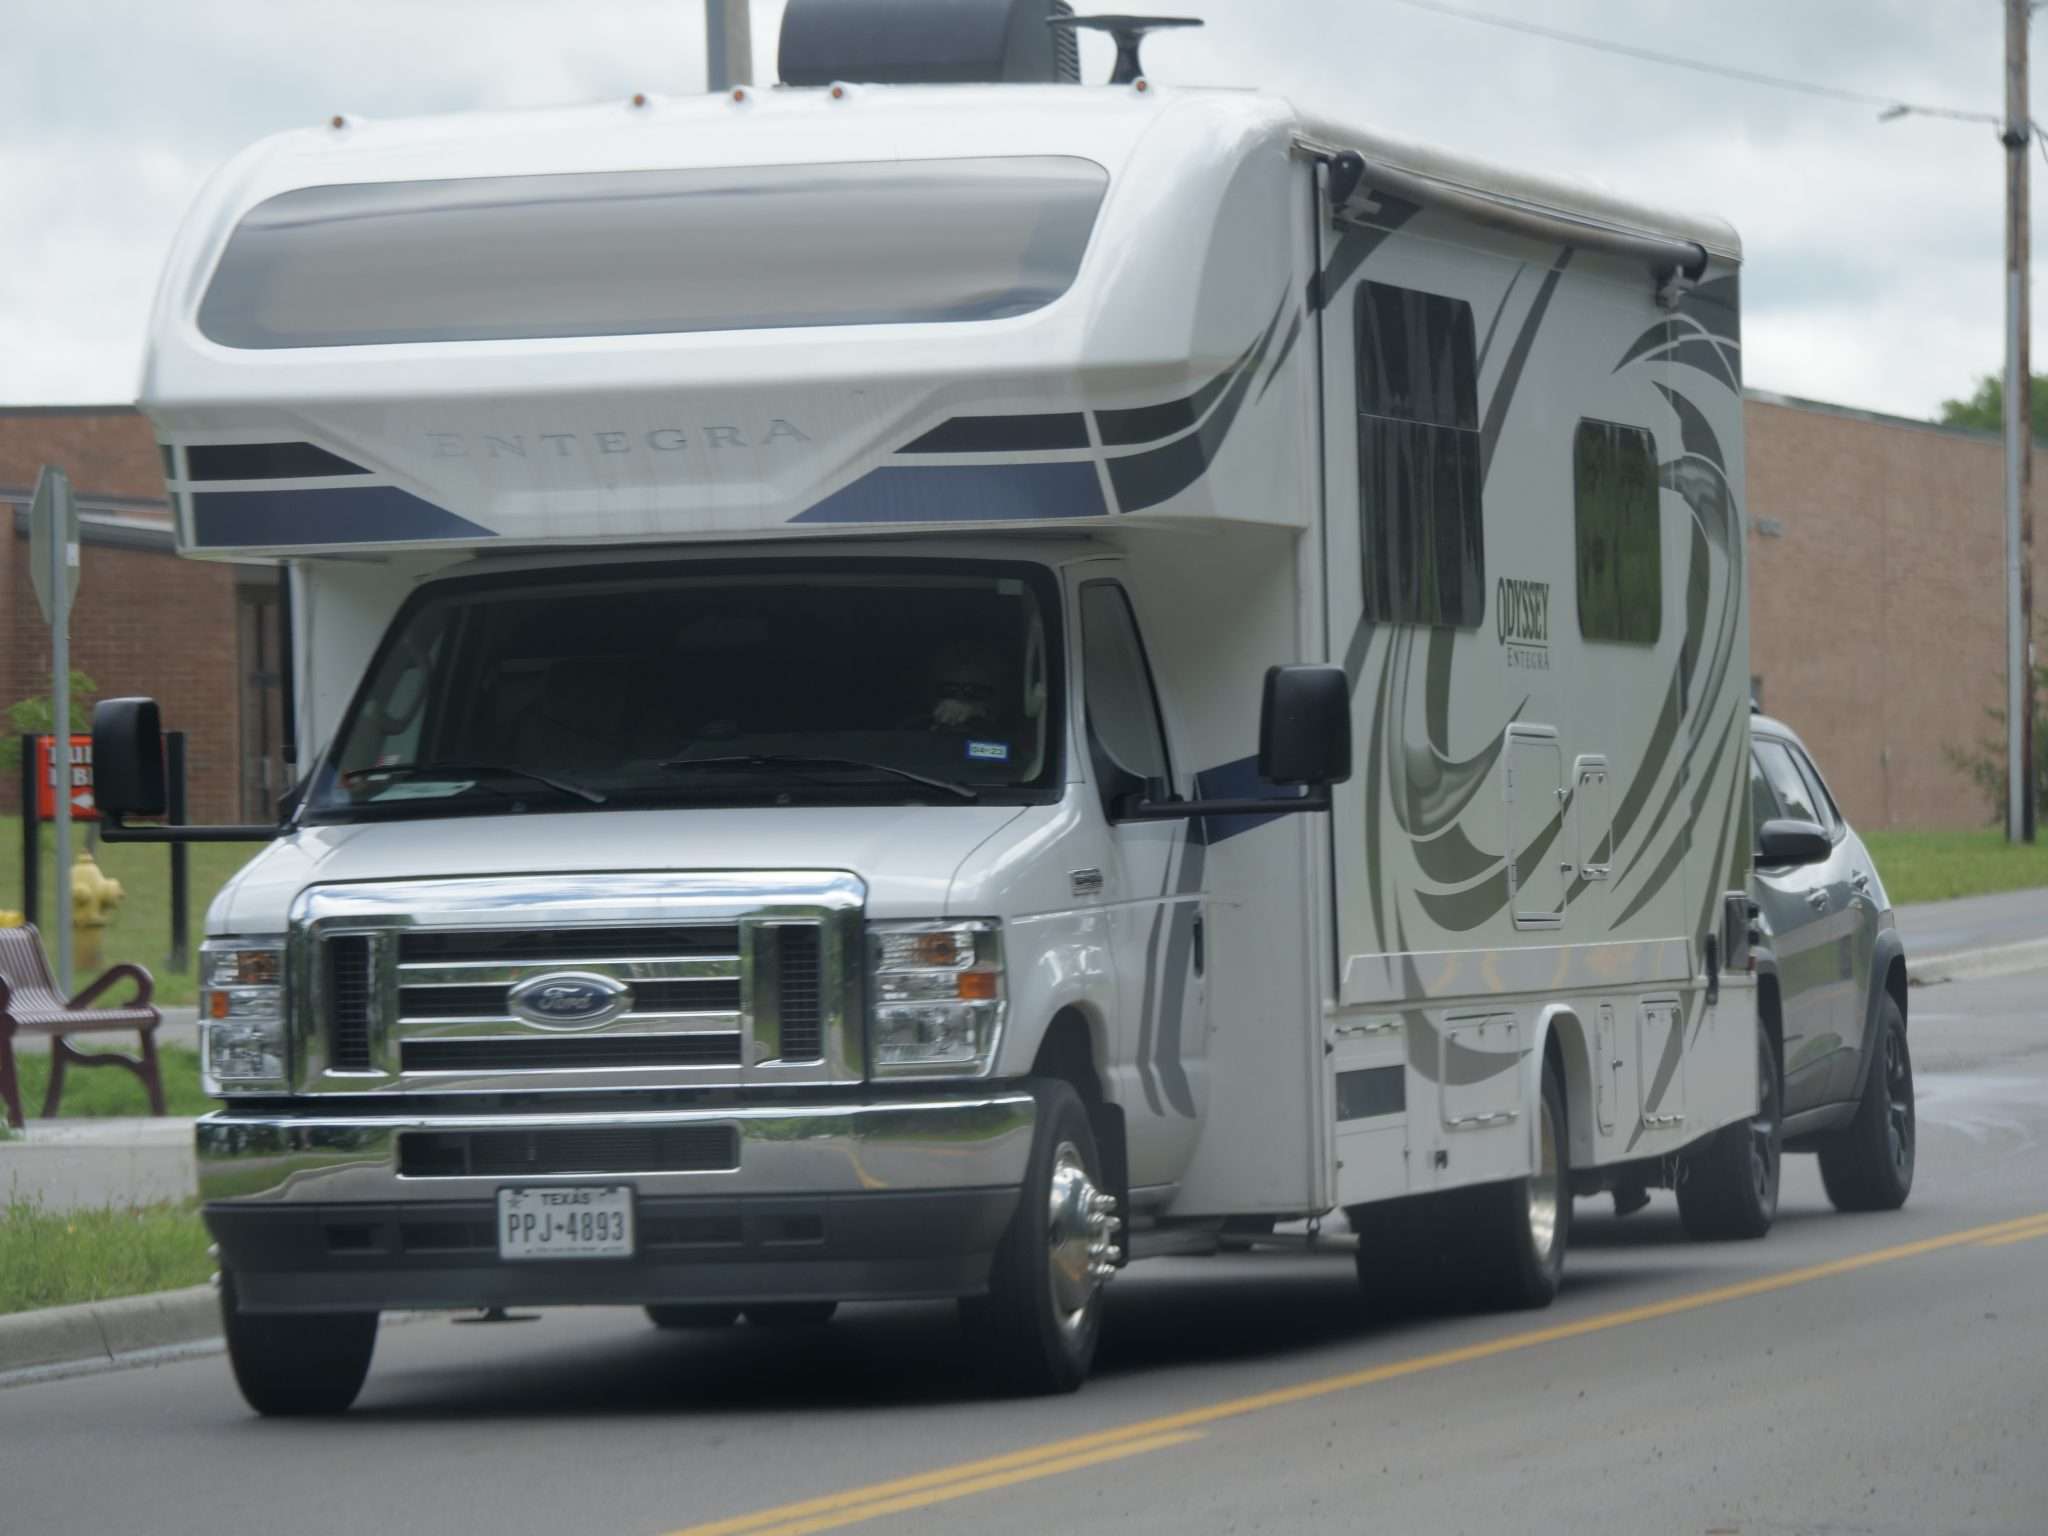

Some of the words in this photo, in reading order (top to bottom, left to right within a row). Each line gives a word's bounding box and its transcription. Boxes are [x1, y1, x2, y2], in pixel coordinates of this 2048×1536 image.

[424, 418, 812, 458] ENTEGRA
[1496, 575, 1549, 646] ODYSSEY
[539, 987, 592, 1010] Ford
[541, 1193, 590, 1205] TEXAS
